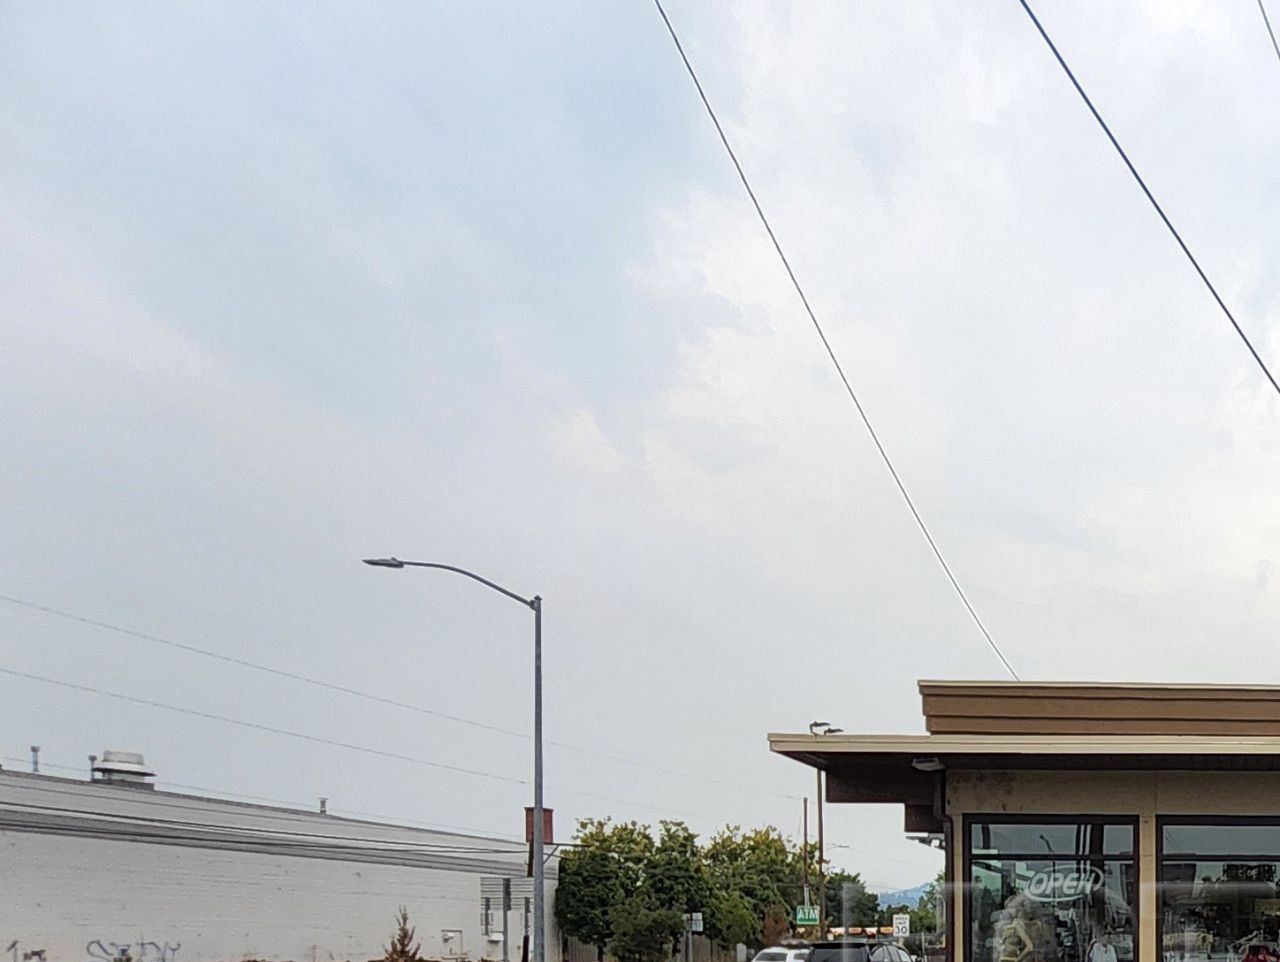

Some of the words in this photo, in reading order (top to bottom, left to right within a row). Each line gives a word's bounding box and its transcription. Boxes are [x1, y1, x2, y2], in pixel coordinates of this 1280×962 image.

[1030, 872, 1096, 895] OPEN
[798, 908, 819, 919] ATM
[895, 926, 908, 934] 30
